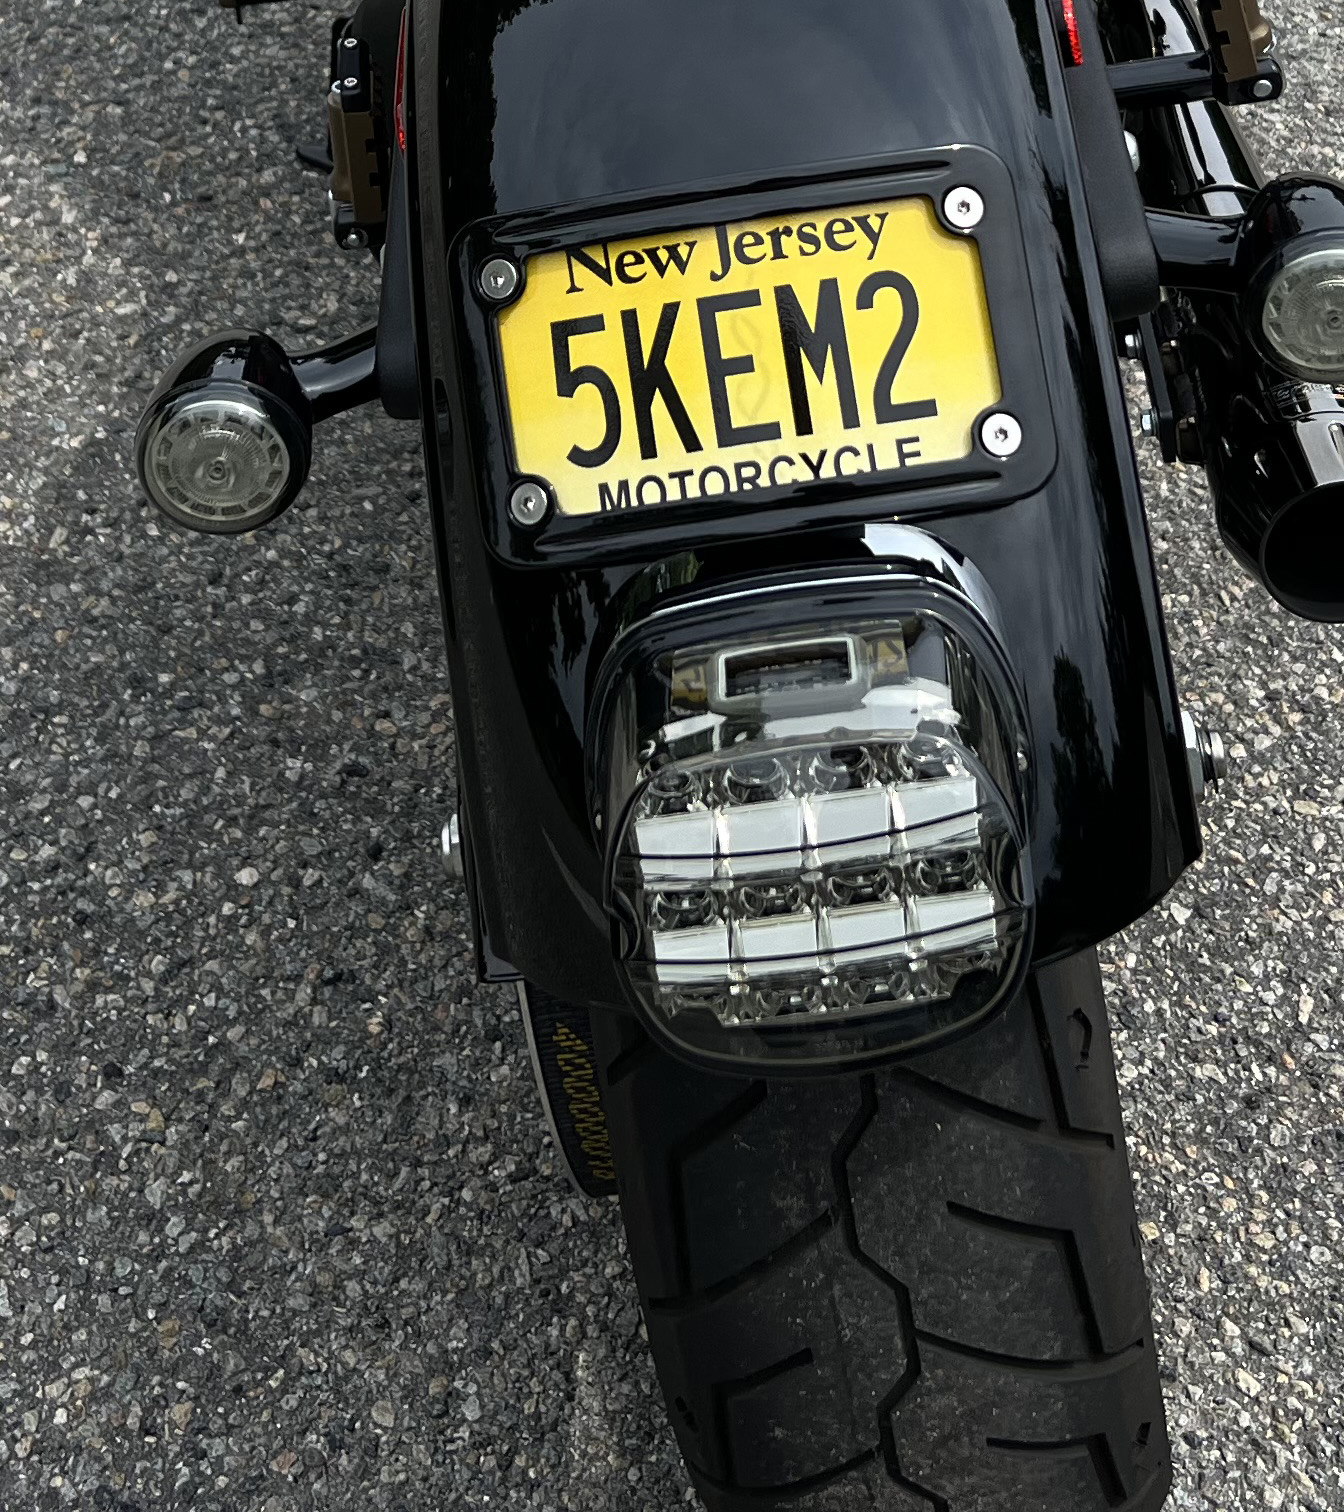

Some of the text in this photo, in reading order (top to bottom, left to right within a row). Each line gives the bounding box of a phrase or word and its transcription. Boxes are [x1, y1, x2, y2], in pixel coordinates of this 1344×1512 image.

[565, 211, 889, 294] New Jersey
[549, 270, 938, 469] 5KEM2
